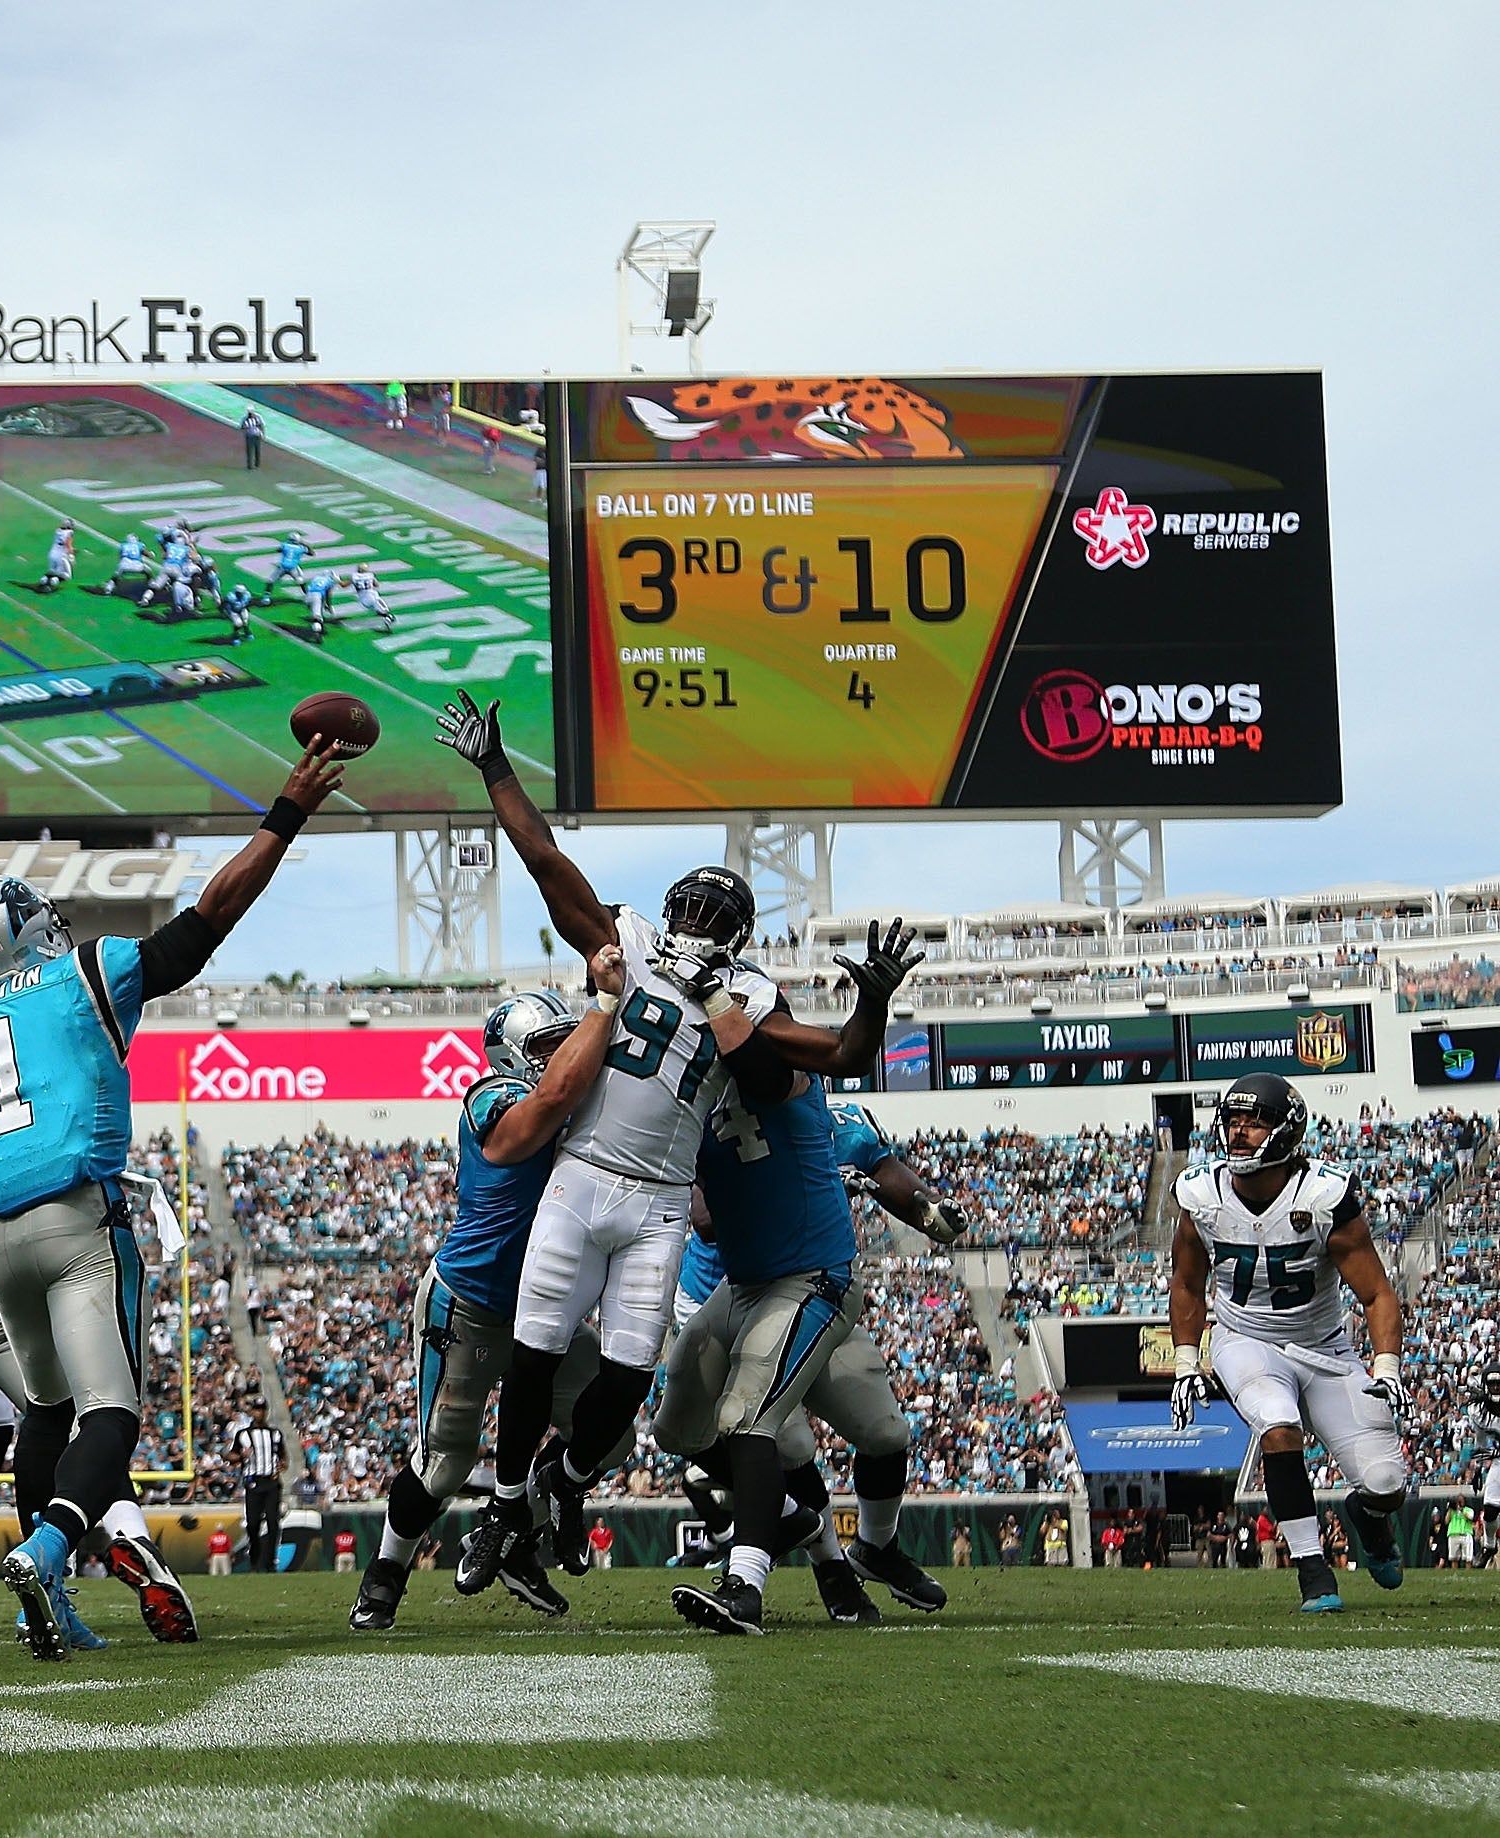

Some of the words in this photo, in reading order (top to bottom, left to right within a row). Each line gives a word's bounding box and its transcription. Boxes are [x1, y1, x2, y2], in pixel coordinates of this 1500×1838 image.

[141, 298, 316, 365] Field
[596, 493, 657, 518] BALL
[663, 493, 696, 517] ON
[703, 493, 718, 517] 7
[724, 493, 756, 516] YD
[762, 492, 815, 516] LINE
[1162, 512, 1301, 536] REPUBLIC
[1193, 533, 1270, 551] SERVICES
[837, 534, 968, 625] 10
[620, 646, 665, 665] GAME
[669, 646, 706, 665] TIME
[823, 643, 898, 662] QUARTER
[49, 677, 94, 698] 10
[633, 667, 739, 710] 9:51
[847, 670, 876, 710] 4
[1111, 725, 1154, 748] PIT
[1158, 725, 1263, 752] BAR-B-Q
[1151, 748, 1184, 766] SINCE
[3, 842, 308, 900] LIGH
[1040, 1023, 1111, 1052] TAYLOR
[1196, 1039, 1247, 1062] FANTASY
[1250, 1037, 1294, 1058] UPDATE
[190, 1065, 328, 1100] xome
[949, 1063, 977, 1085] YDS
[1027, 1062, 1047, 1083] TD
[1102, 1060, 1124, 1081] INT
[1212, 1239, 1317, 1311] 75
